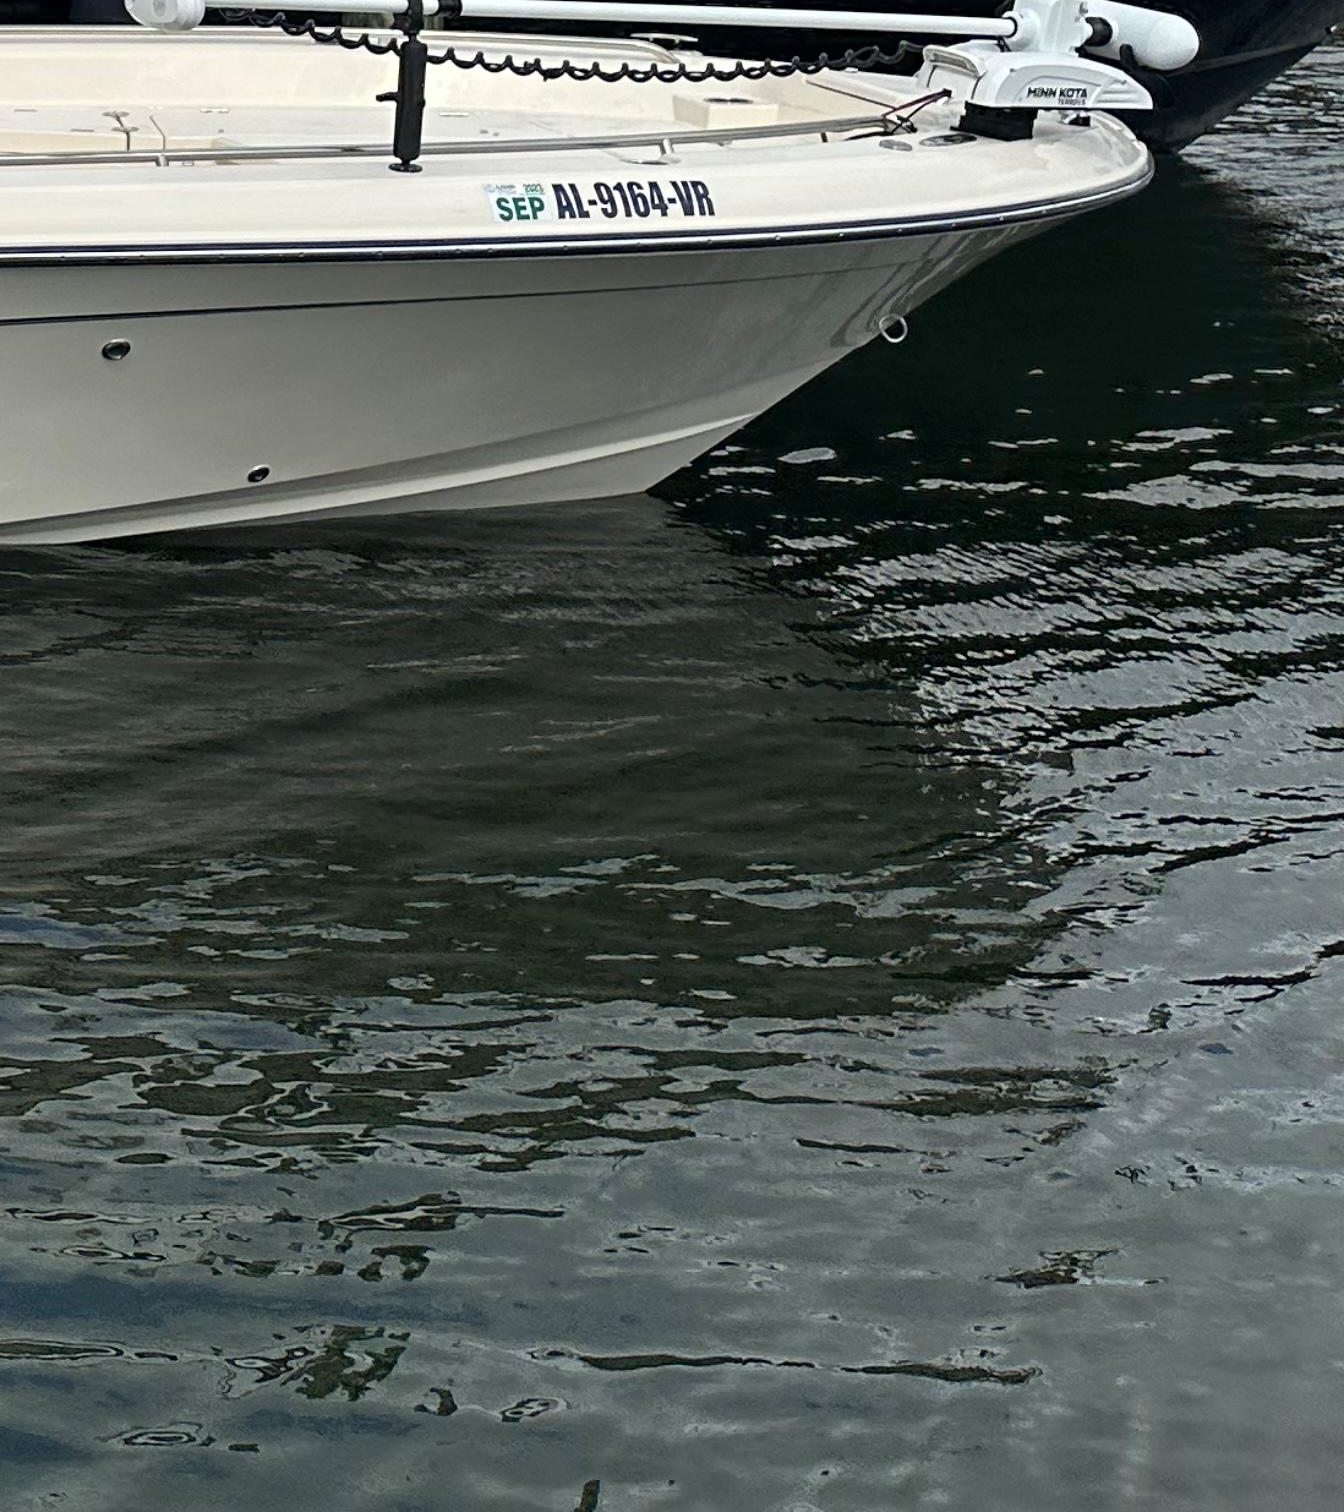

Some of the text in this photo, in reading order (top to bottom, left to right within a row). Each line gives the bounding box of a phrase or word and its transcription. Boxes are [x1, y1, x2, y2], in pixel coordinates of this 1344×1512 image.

[1059, 87, 1088, 99] KOTA
[496, 196, 545, 221] SEP
[551, 180, 716, 220] AL-9164-VR
